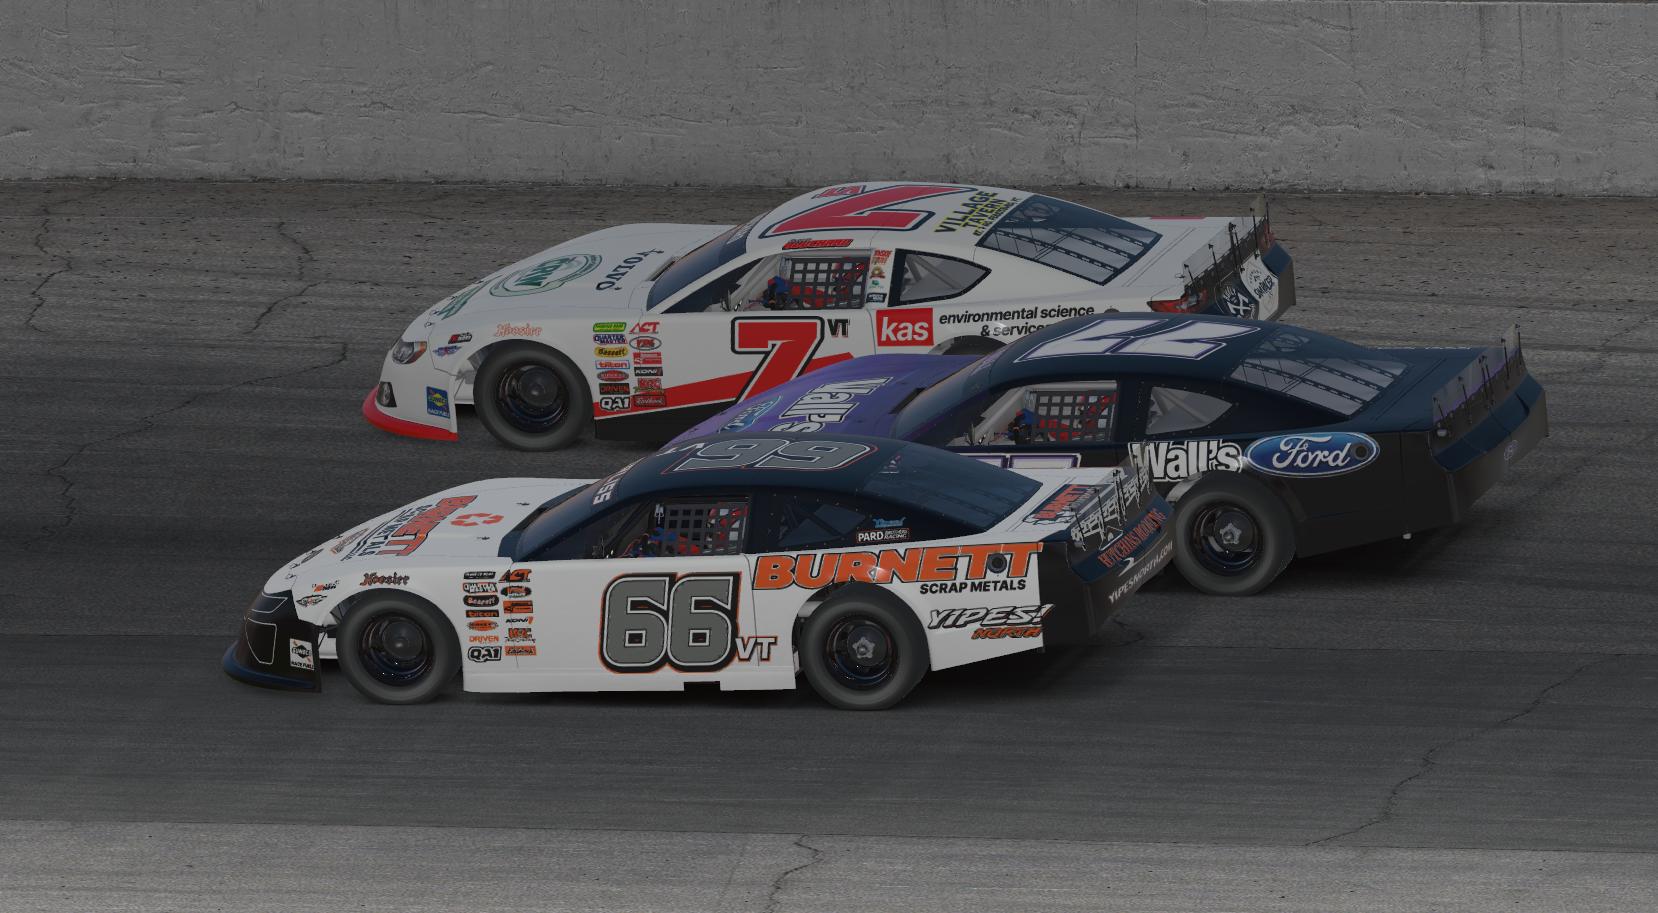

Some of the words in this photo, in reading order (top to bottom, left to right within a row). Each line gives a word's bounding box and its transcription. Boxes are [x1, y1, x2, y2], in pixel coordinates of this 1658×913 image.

[758, 184, 978, 239] 7
[934, 191, 999, 233] VILLAGE
[961, 198, 1007, 229] TAVERN
[629, 321, 660, 334] ACT
[939, 306, 1038, 325] environmental
[1040, 304, 1095, 319] science
[495, 323, 543, 337] Hoosier
[880, 315, 930, 342] kas
[980, 324, 991, 337] &
[1014, 319, 1261, 362] 77
[731, 315, 825, 405] 7
[827, 318, 850, 338] VT
[600, 397, 630, 410] QA1
[1129, 439, 1243, 481] Wall's
[1272, 436, 1351, 469] Ford
[858, 531, 884, 542] PARD
[359, 571, 410, 586] Hoosier
[752, 542, 1044, 590] BURNETT
[919, 582, 969, 595] SCRAP
[970, 579, 1026, 593] METALS
[599, 572, 741, 674] 66
[735, 636, 778, 662] VT
[927, 603, 1056, 630] YIPES!
[469, 635, 499, 643] DRIVEN
[468, 646, 502, 662] QA1
